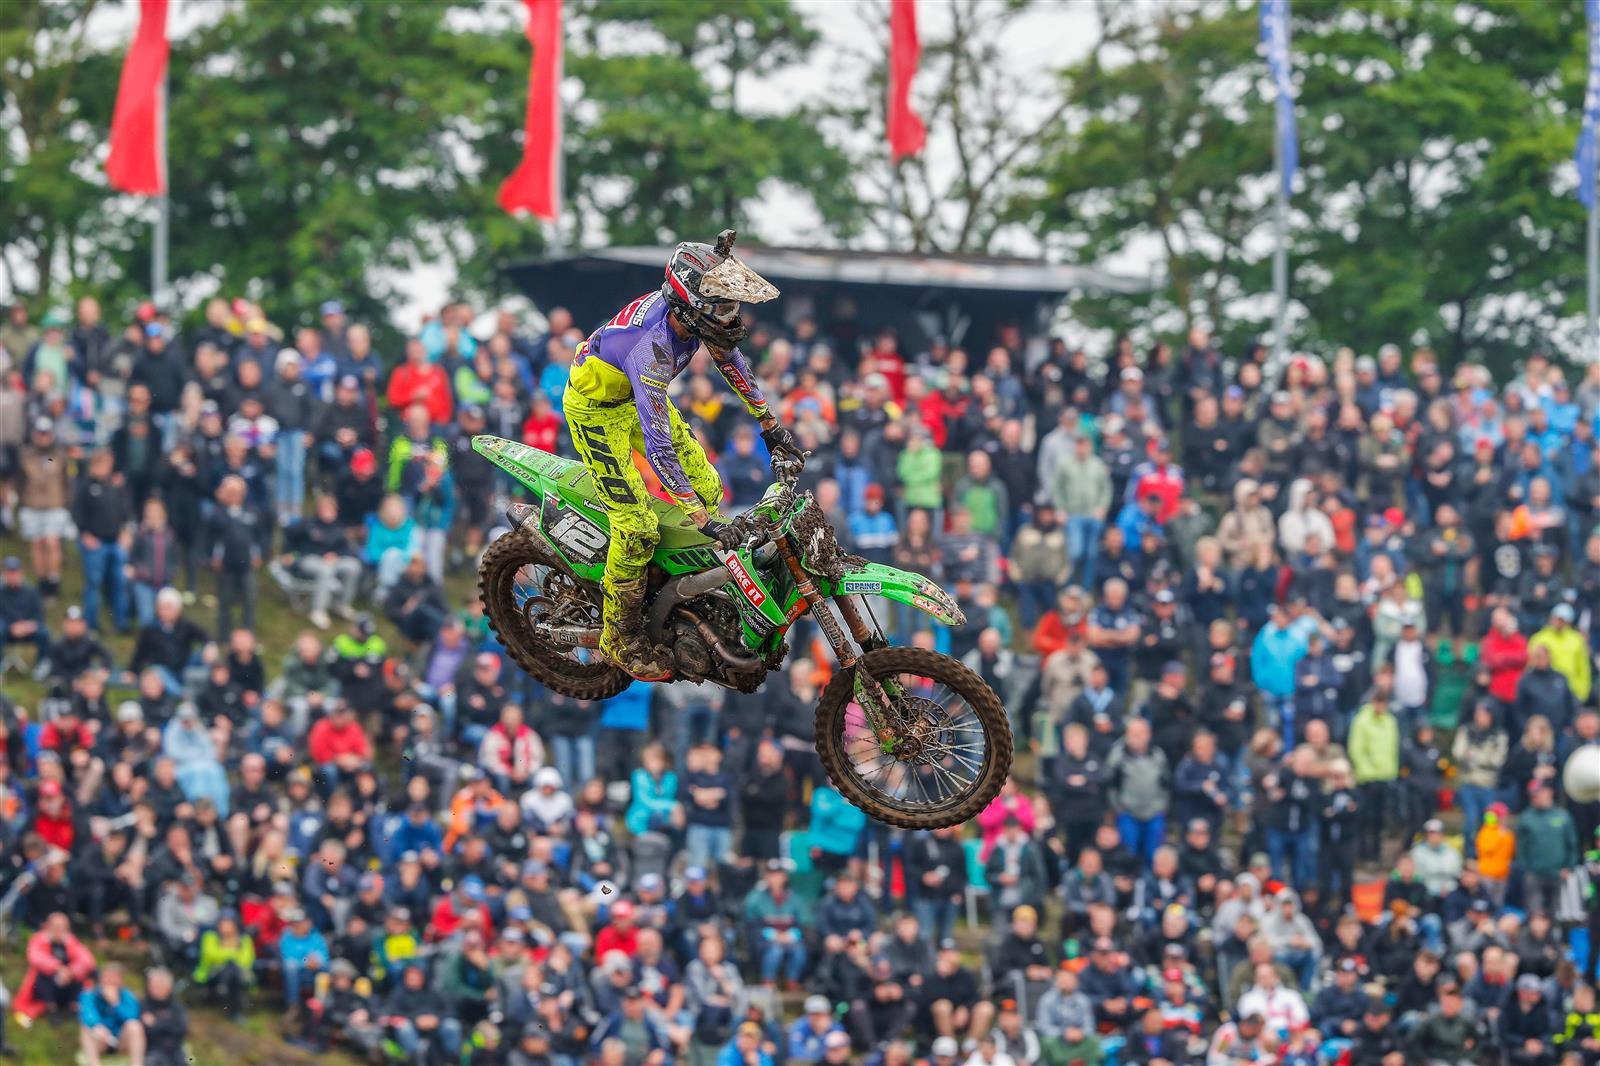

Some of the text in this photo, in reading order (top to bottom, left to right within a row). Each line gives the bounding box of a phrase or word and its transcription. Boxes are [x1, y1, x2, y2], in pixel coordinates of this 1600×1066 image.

[499, 456, 536, 483] DUNLOP
[580, 425, 638, 504] UFO
[651, 453, 679, 490] Kawasaki
[548, 512, 607, 558] 12
[728, 559, 751, 589] BIKE
[748, 588, 762, 601] IT
[855, 582, 880, 590] PAINES
